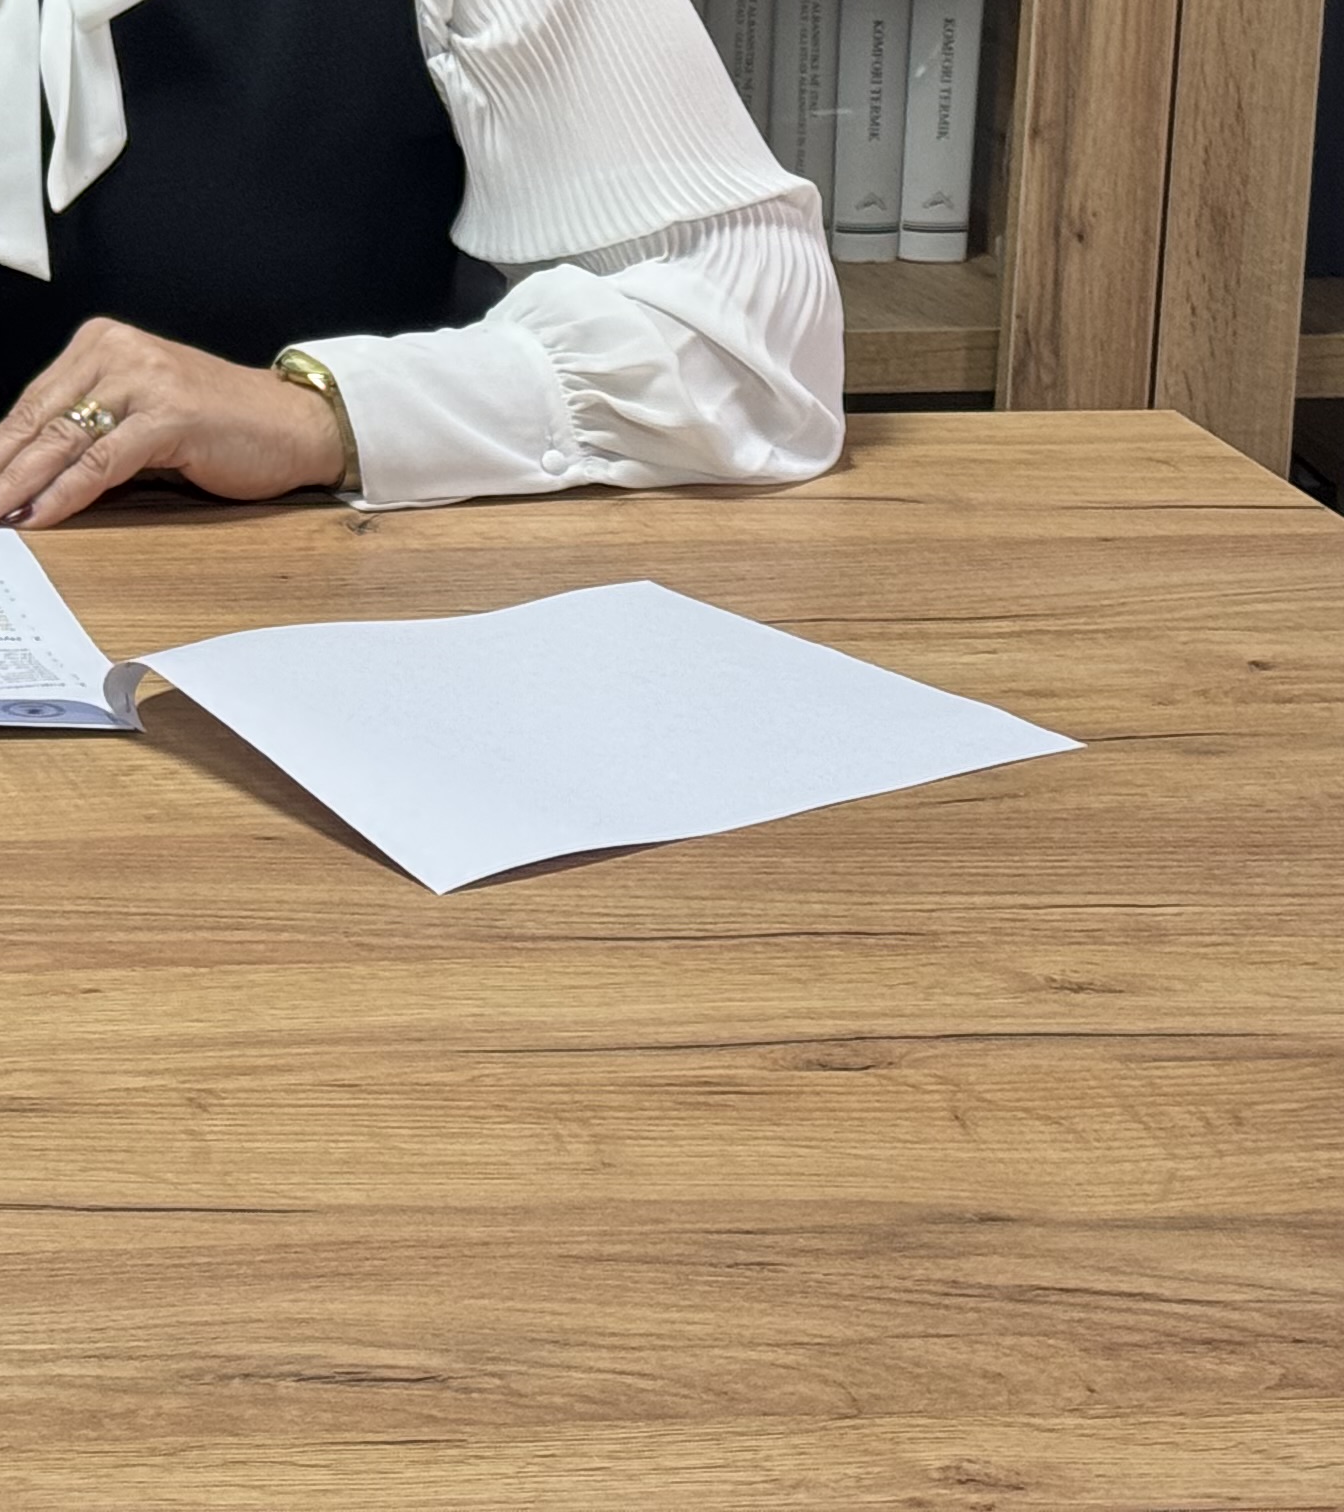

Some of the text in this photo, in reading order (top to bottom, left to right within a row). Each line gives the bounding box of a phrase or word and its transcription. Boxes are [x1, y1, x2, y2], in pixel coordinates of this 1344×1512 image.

[867, 19, 886, 143] KOMFORI TERMIK
[935, 17, 957, 141] KOMFORI TERMIK
